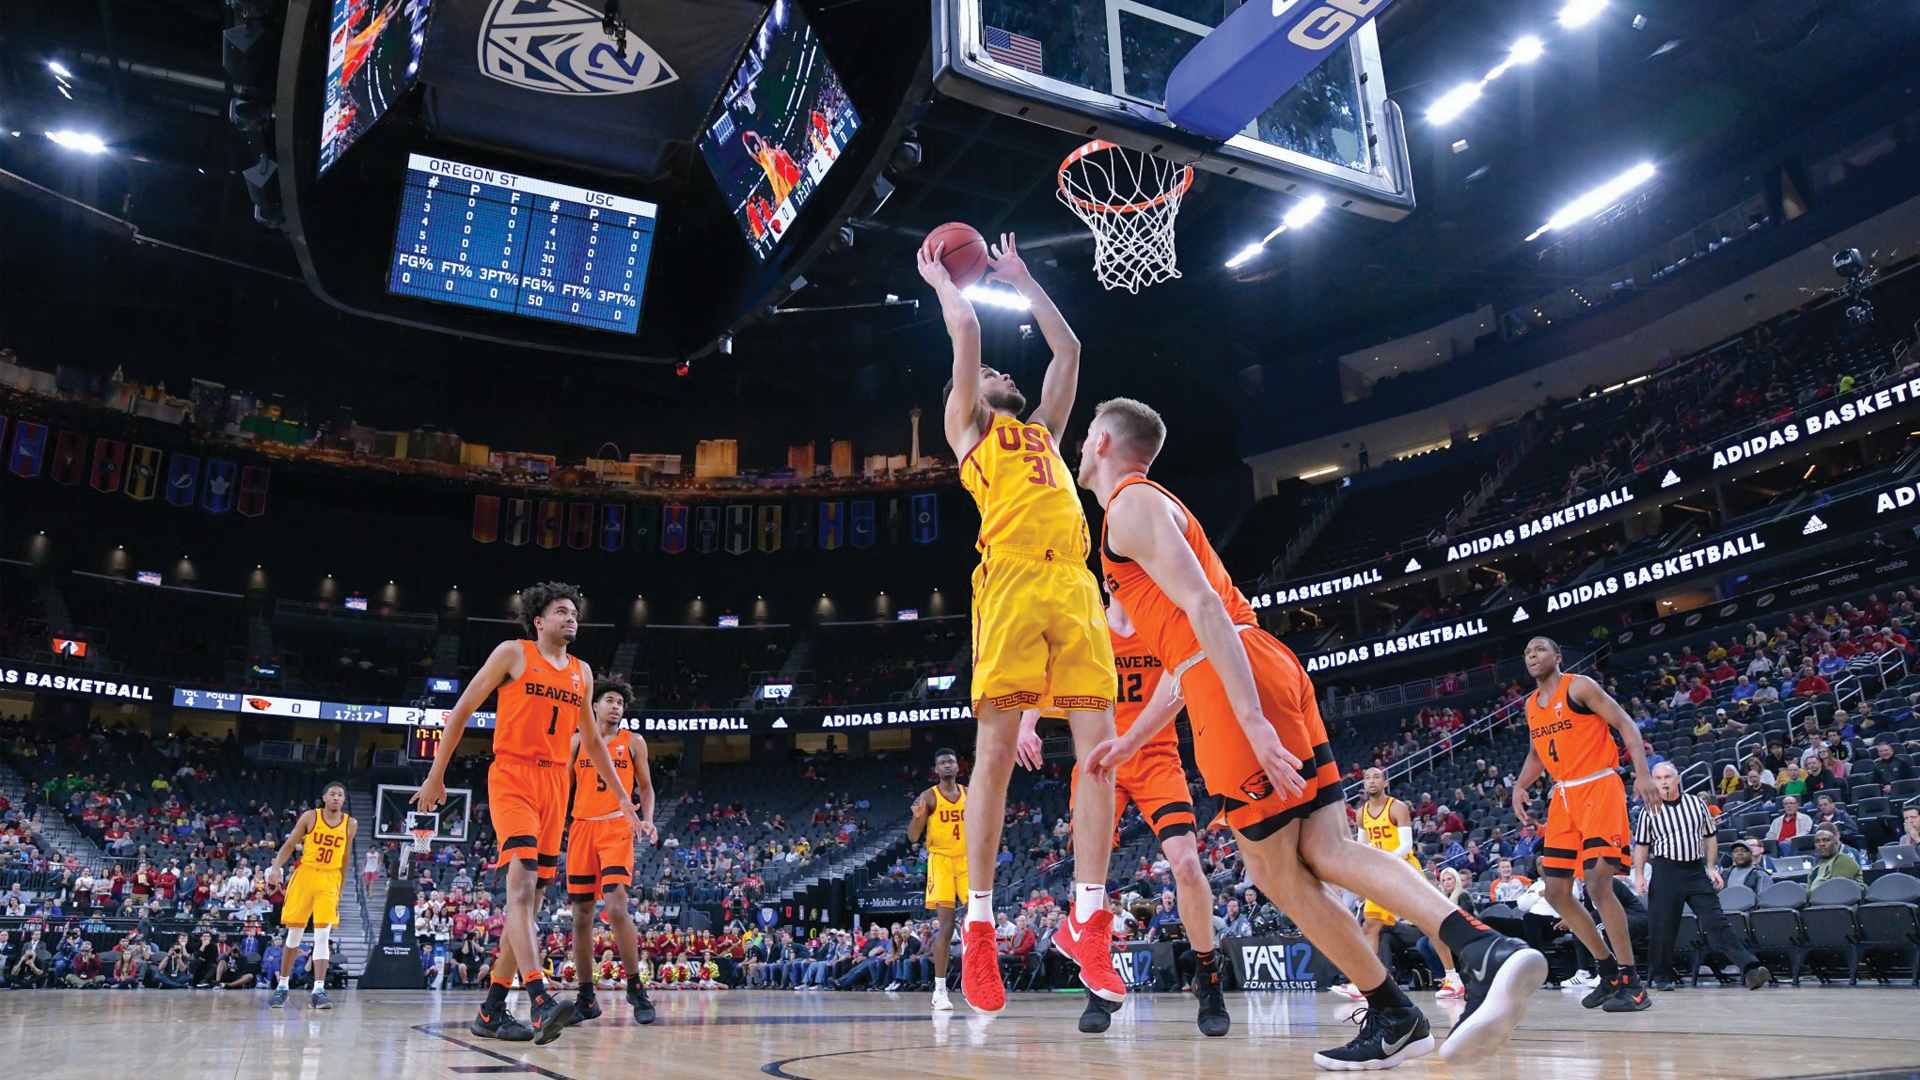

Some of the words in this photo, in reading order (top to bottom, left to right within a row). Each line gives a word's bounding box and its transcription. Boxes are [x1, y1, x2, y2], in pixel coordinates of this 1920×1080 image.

[429, 159, 495, 182] OREGON
[499, 174, 519, 187] ST
[814, 158, 824, 173] 2
[426, 190, 432, 199] 1
[468, 198, 476, 207] 0
[510, 206, 518, 215] 0
[428, 176, 440, 188] #
[470, 184, 480, 196] P
[511, 192, 521, 204] F
[585, 191, 615, 207] USC
[423, 203, 431, 213] 3
[466, 211, 474, 221] 0
[508, 219, 516, 229] 0
[549, 200, 560, 212] #
[589, 208, 599, 220] P
[627, 216, 637, 228] F
[421, 217, 428, 226] 4
[464, 225, 471, 235] 0
[506, 233, 513, 243] 1
[551, 215, 558, 224] 2
[592, 223, 599, 232] 2
[632, 231, 640, 240] 0
[419, 230, 427, 240] 5
[461, 239, 469, 248] 0
[503, 246, 511, 256] 0
[544, 240, 556, 251] 11
[587, 248, 595, 258] 0
[628, 256, 635, 266] 0
[550, 228, 556, 237] 4
[589, 235, 597, 245] 0
[630, 243, 638, 253] 0
[414, 243, 428, 255] 12
[459, 252, 467, 262] 0
[501, 259, 509, 269] 0
[541, 253, 555, 264] 30
[585, 261, 592, 271] 0
[626, 269, 633, 279] 0
[399, 253, 434, 271] FG%
[441, 260, 473, 278] FT%
[479, 267, 519, 286] 3PT%
[540, 267, 552, 278] 31
[583, 275, 590, 284] 0
[623, 282, 631, 292] 0
[402, 272, 411, 283] 0
[445, 280, 454, 291] 0
[490, 288, 498, 299] 0
[522, 276, 555, 293] FG%
[562, 283, 592, 300] FT%
[598, 289, 636, 307] 3PT%
[528, 294, 543, 306] 50
[571, 302, 580, 313] 0
[613, 310, 622, 320] 0
[1711, 423, 1800, 470] ADIDAS
[1023, 455, 1057, 489] 31
[1446, 529, 1516, 562] ADIDAS
[1518, 486, 1635, 540] BASKETBALL
[1546, 577, 1620, 613] ADIDAS
[1623, 532, 1766, 588] BASKETBALL
[1875, 559, 1909, 574] credible
[1275, 568, 1383, 605] BASKETBALL
[1790, 583, 1820, 597] credible
[1828, 572, 1860, 587] credible
[1306, 645, 1370, 673] ADIDAS
[1373, 617, 1488, 658] BASKETBALL
[25, 672, 153, 700] BASKETBALL
[181, 689, 199, 698] TOL
[206, 692, 236, 701] FOULS
[525, 682, 583, 708] BEAVERS
[1116, 672, 1143, 703] 12
[185, 697, 194, 707] 4
[216, 699, 224, 709] 1
[291, 703, 302, 714] 0
[335, 710, 372, 722] 17:17
[406, 711, 416, 722] 2
[477, 718, 486, 727] 0
[547, 705, 559, 735] 1
[645, 717, 749, 731] BASKETBALL
[822, 712, 883, 728] ADIDAS
[1531, 719, 1573, 740] BEAVERS
[1548, 738, 1560, 762] 4
[313, 832, 344, 848] USC
[952, 824, 960, 840] 4
[315, 846, 334, 864] 30
[1243, 979, 1318, 991] CONFERENCE
